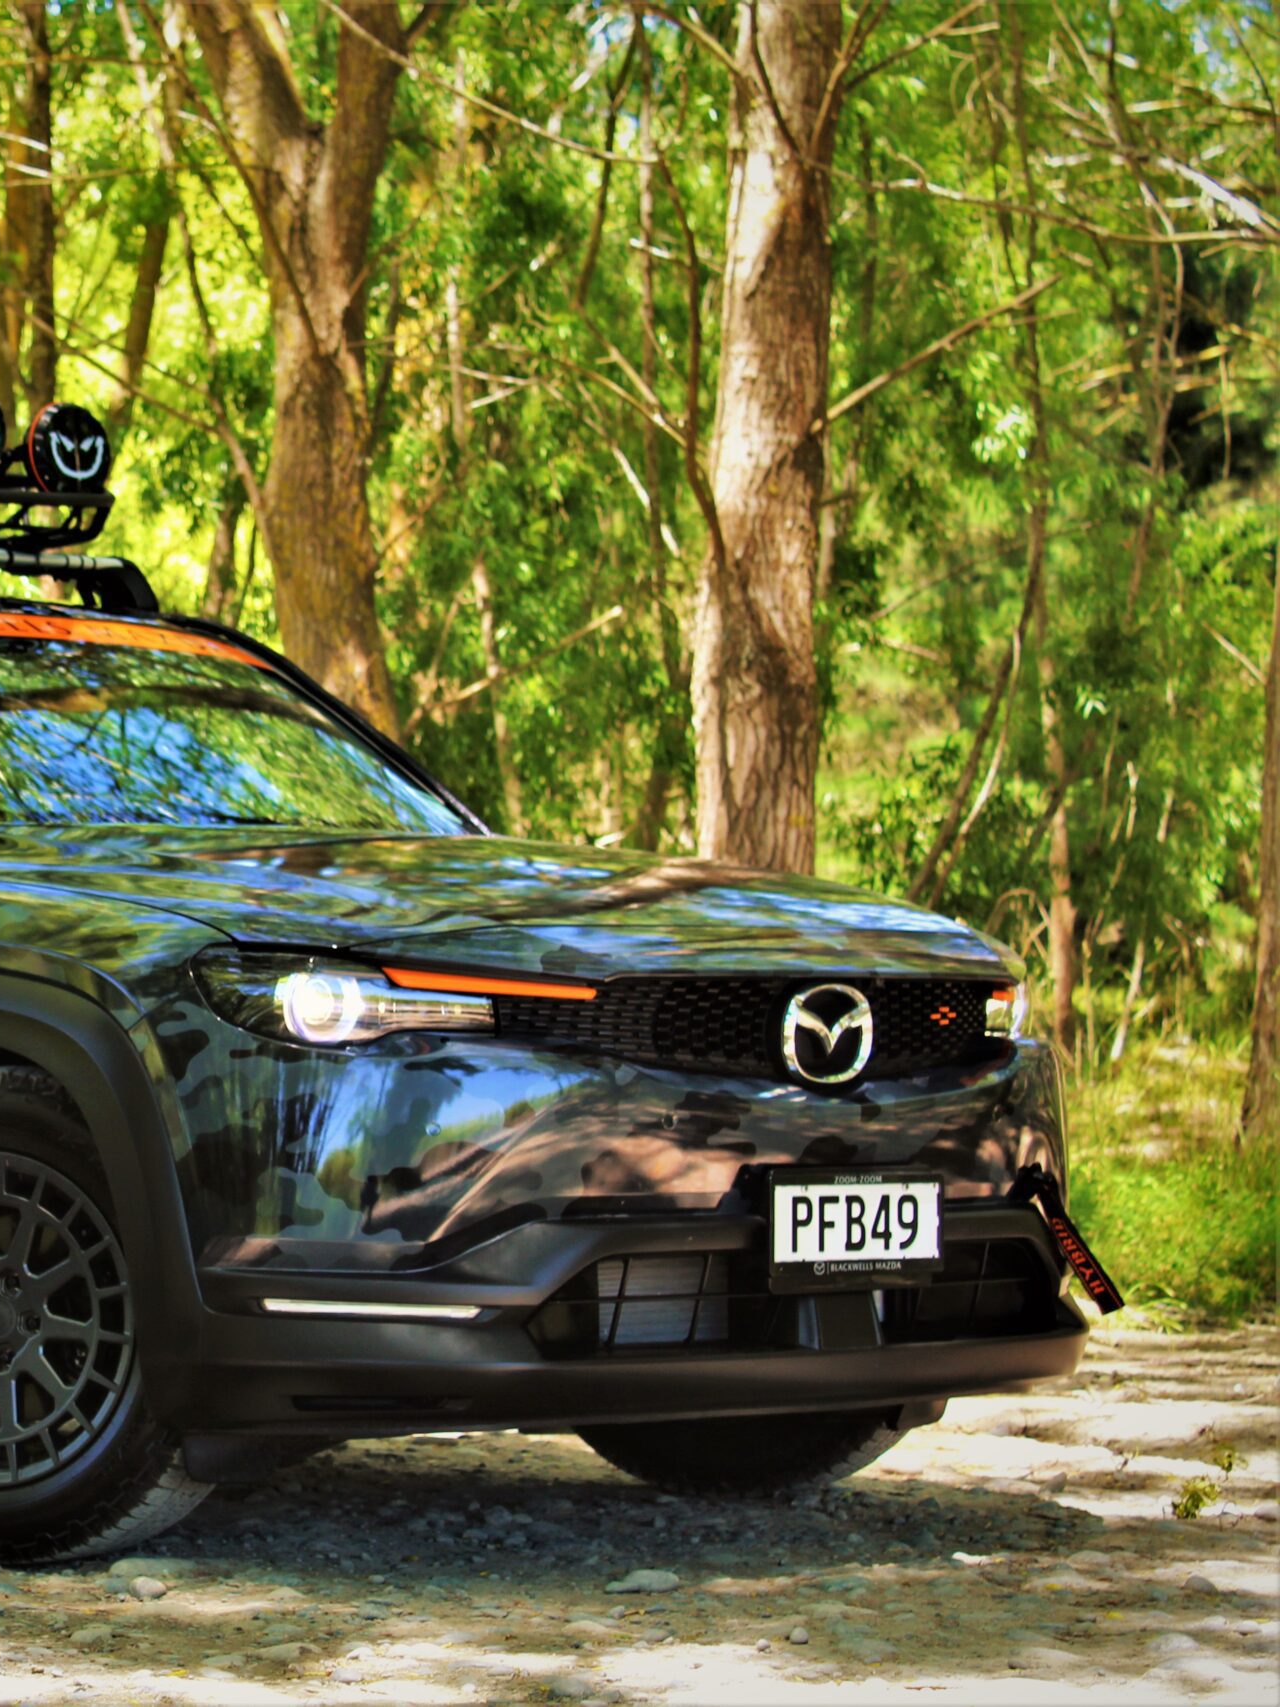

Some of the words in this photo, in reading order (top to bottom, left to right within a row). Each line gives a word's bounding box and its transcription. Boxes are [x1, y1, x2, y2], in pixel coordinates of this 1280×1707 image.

[834, 1175, 882, 1185] ZOOM-ZOOM
[792, 1194, 918, 1253] PFB49
[830, 1261, 873, 1273] BLACKWELLS
[875, 1261, 902, 1271] MAZDA
[1051, 1216, 1105, 1295] HYBRID
